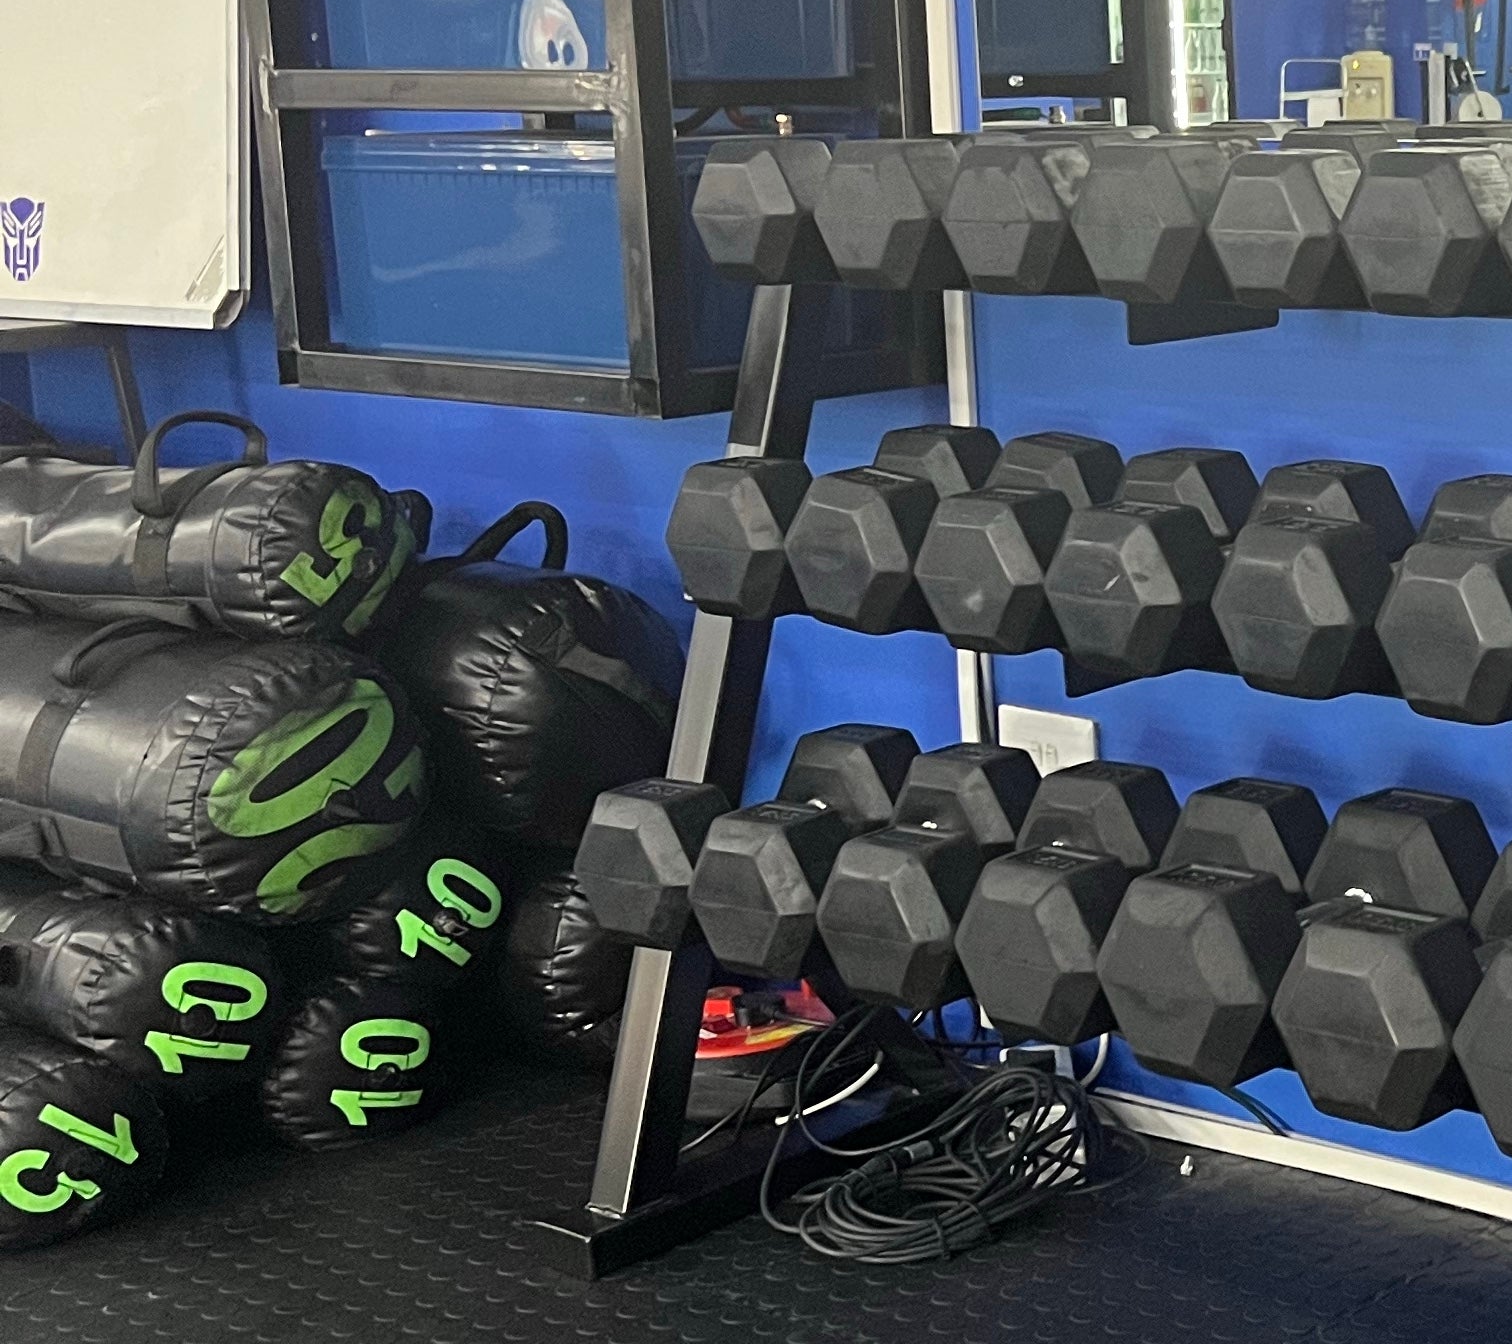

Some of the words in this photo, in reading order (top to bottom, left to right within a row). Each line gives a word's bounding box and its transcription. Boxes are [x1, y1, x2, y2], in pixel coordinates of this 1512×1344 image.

[396, 858, 503, 967] 10
[145, 960, 269, 1075] 10
[330, 1016, 432, 1128] 10
